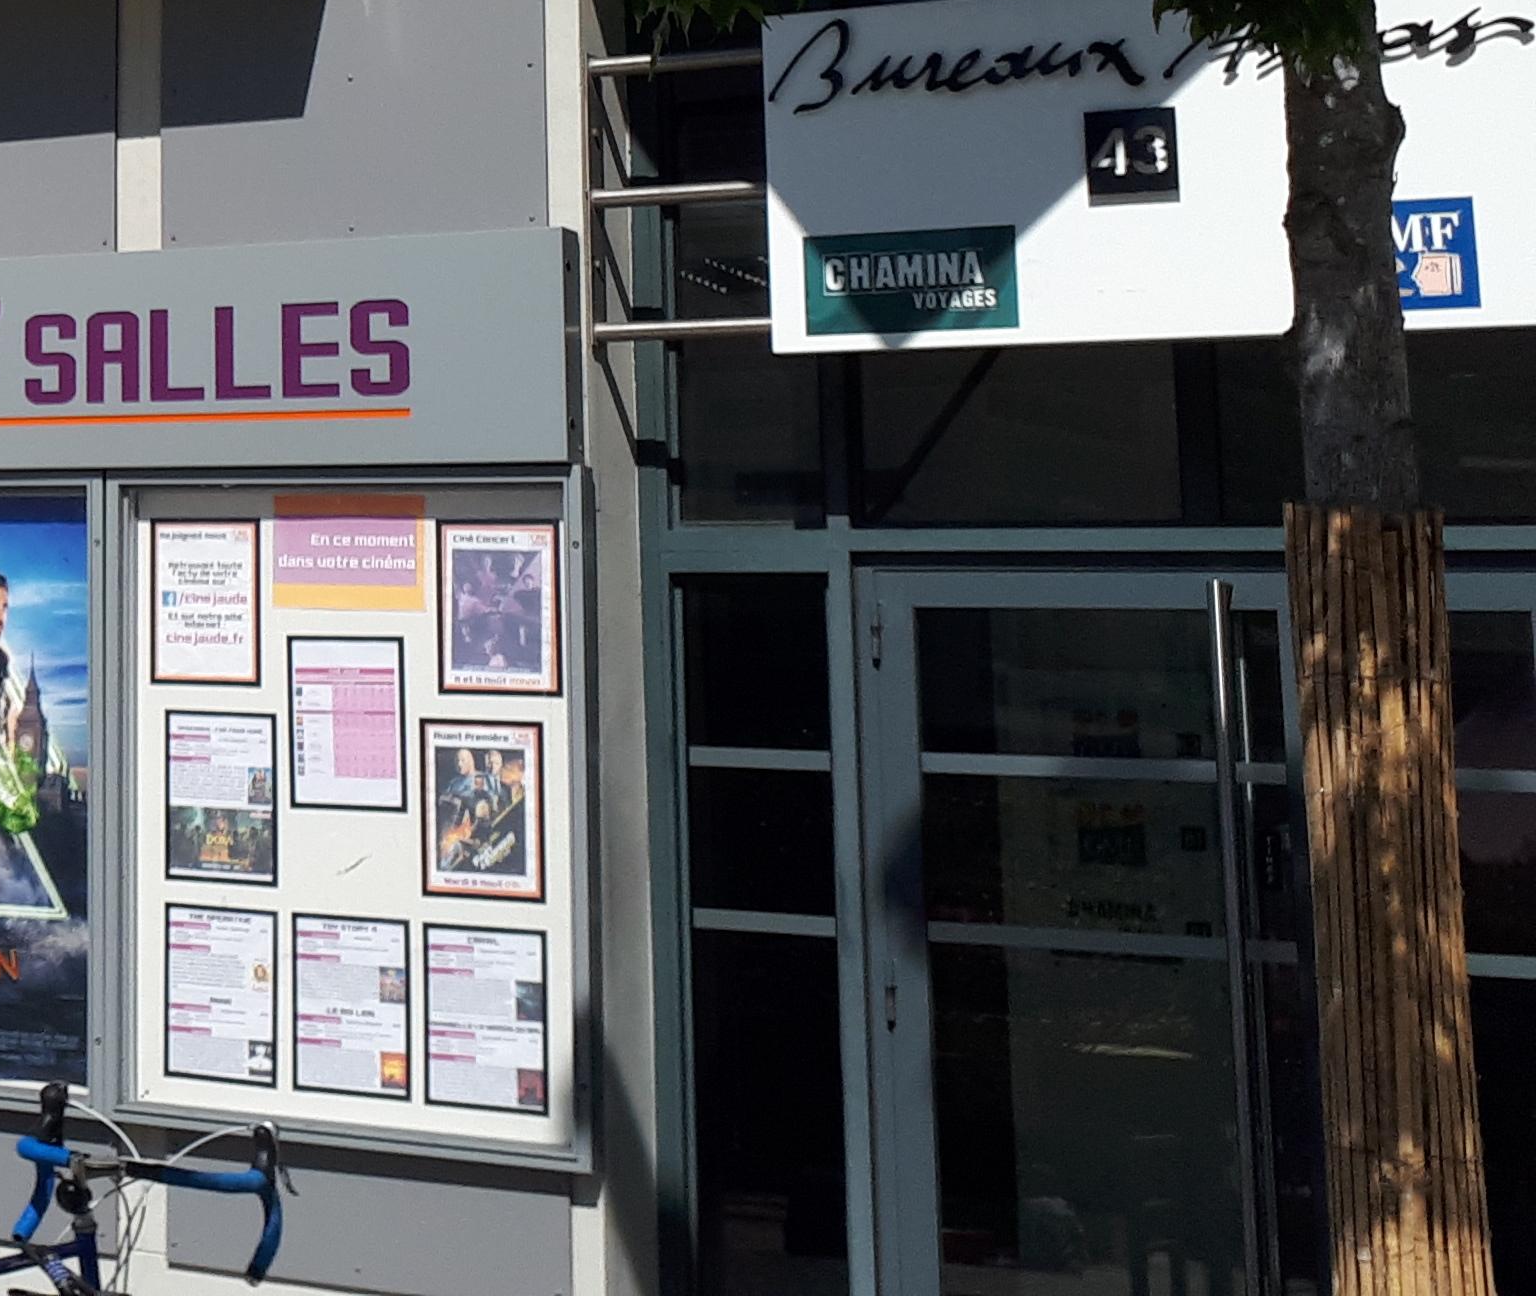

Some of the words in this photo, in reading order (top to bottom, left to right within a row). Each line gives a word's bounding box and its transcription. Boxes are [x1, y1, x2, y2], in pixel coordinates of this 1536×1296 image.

[768, 18, 1146, 115] Bureaux
[1091, 126, 1169, 177] 43
[1390, 210, 1462, 254] MF
[825, 250, 984, 292] CHAMINA
[912, 287, 997, 310] VOYAGES
[24, 298, 410, 406] SALLES
[310, 533, 330, 547] En
[332, 535, 351, 547] ce
[354, 532, 416, 548] moment
[278, 554, 315, 569] dans
[362, 554, 417, 570] cinéma
